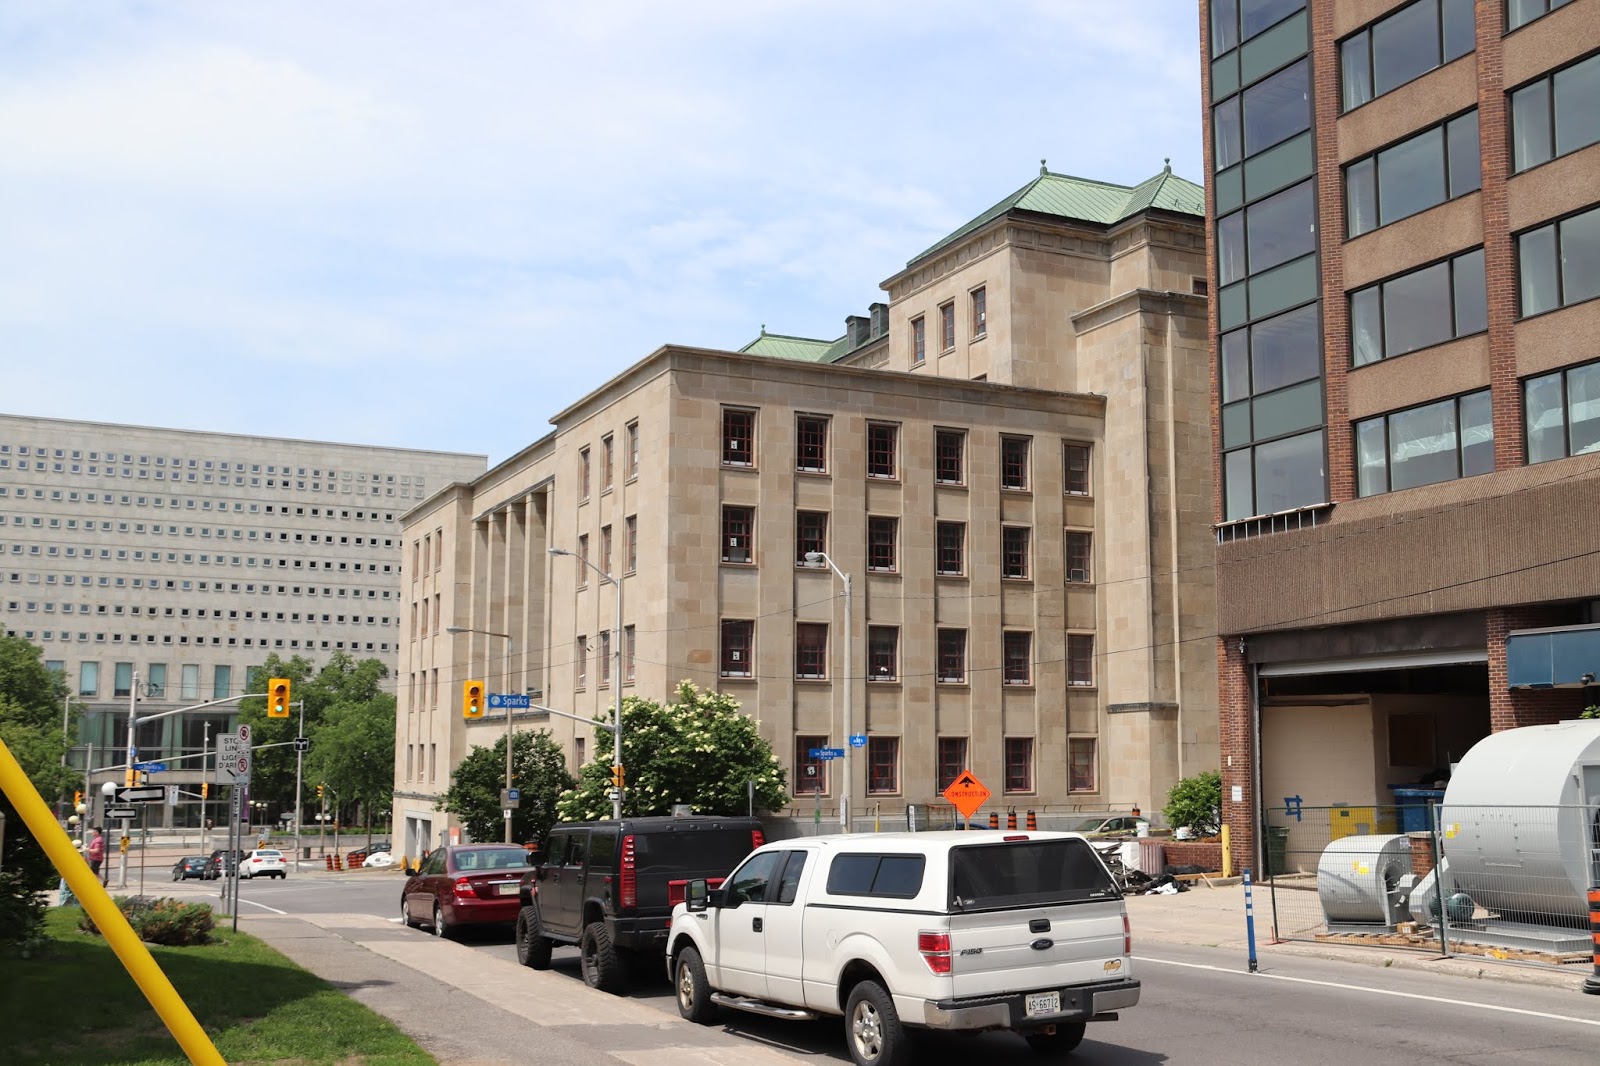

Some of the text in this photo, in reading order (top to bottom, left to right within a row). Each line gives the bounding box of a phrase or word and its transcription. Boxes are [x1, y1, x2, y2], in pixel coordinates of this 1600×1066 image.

[502, 695, 528, 708] Sparks
[223, 737, 238, 745] STO
[1028, 1000, 1037, 1011] AS
[1039, 997, 1059, 1010] 66712
